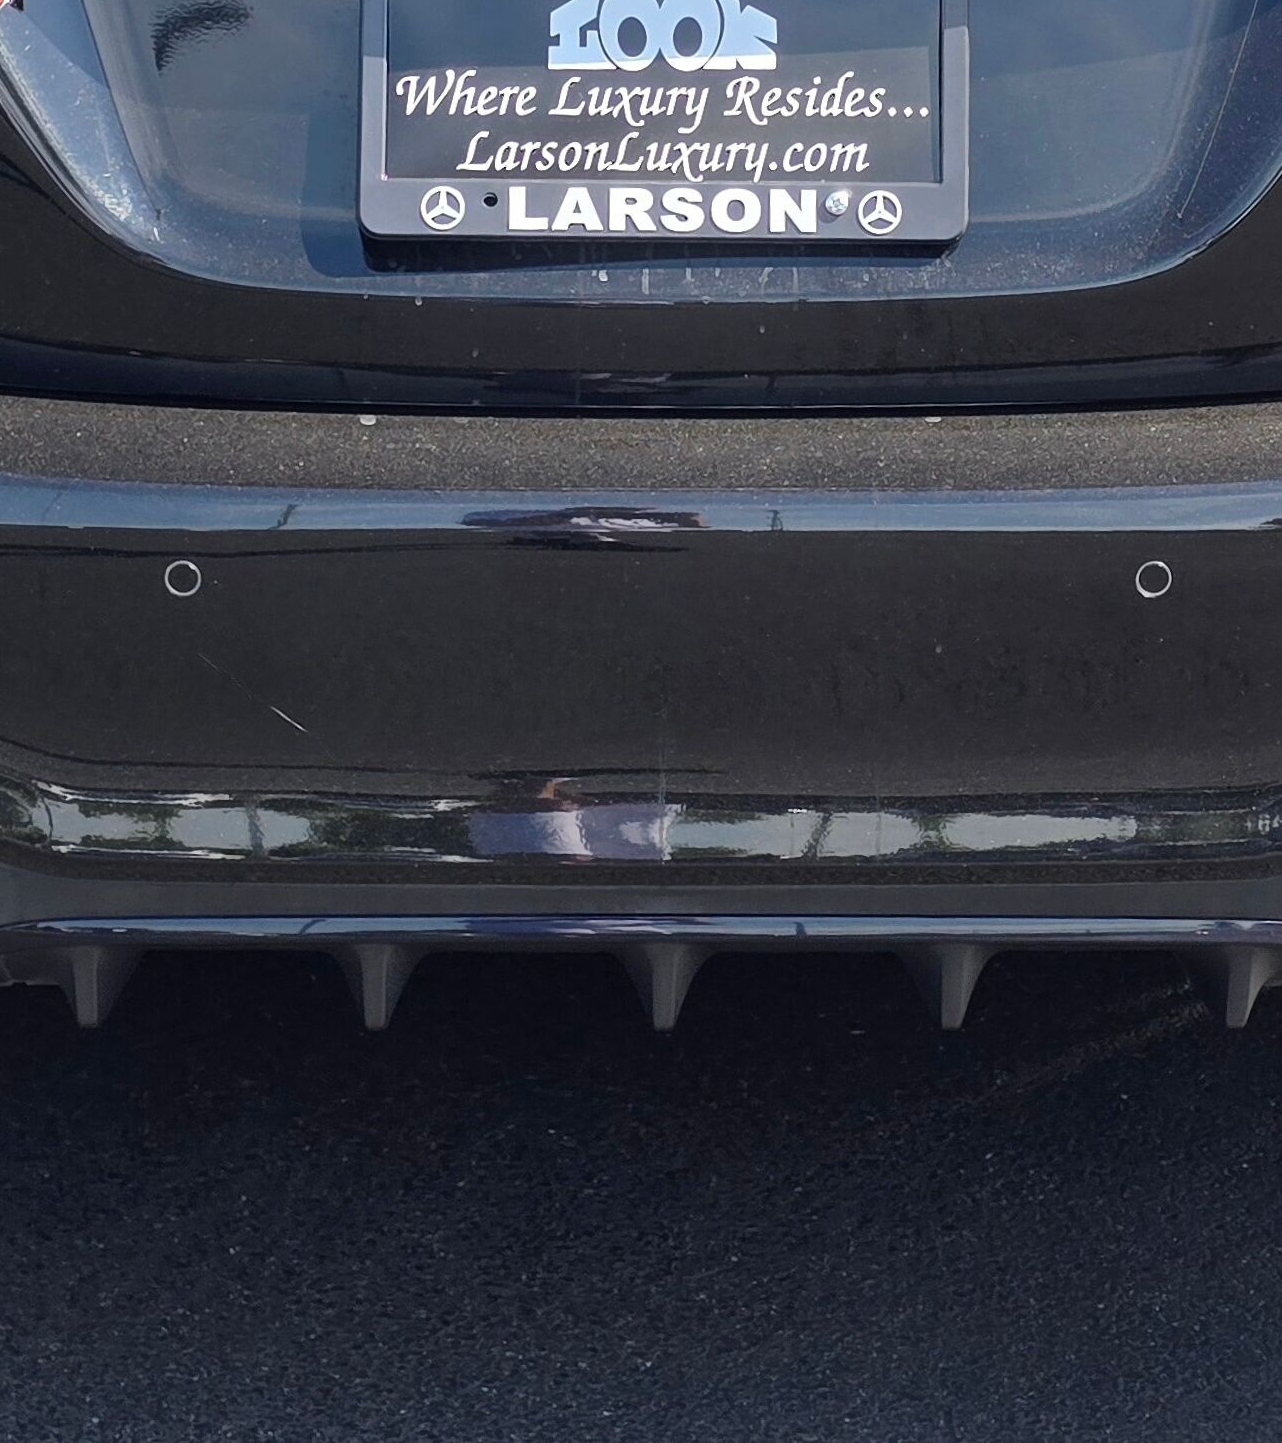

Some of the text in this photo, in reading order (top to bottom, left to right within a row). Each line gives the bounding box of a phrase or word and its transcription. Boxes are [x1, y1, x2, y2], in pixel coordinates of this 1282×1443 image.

[395, 69, 930, 134] Where Luxury Resides...
[456, 131, 870, 183] LarsonLuxury.com
[507, 186, 818, 234] LARSON
